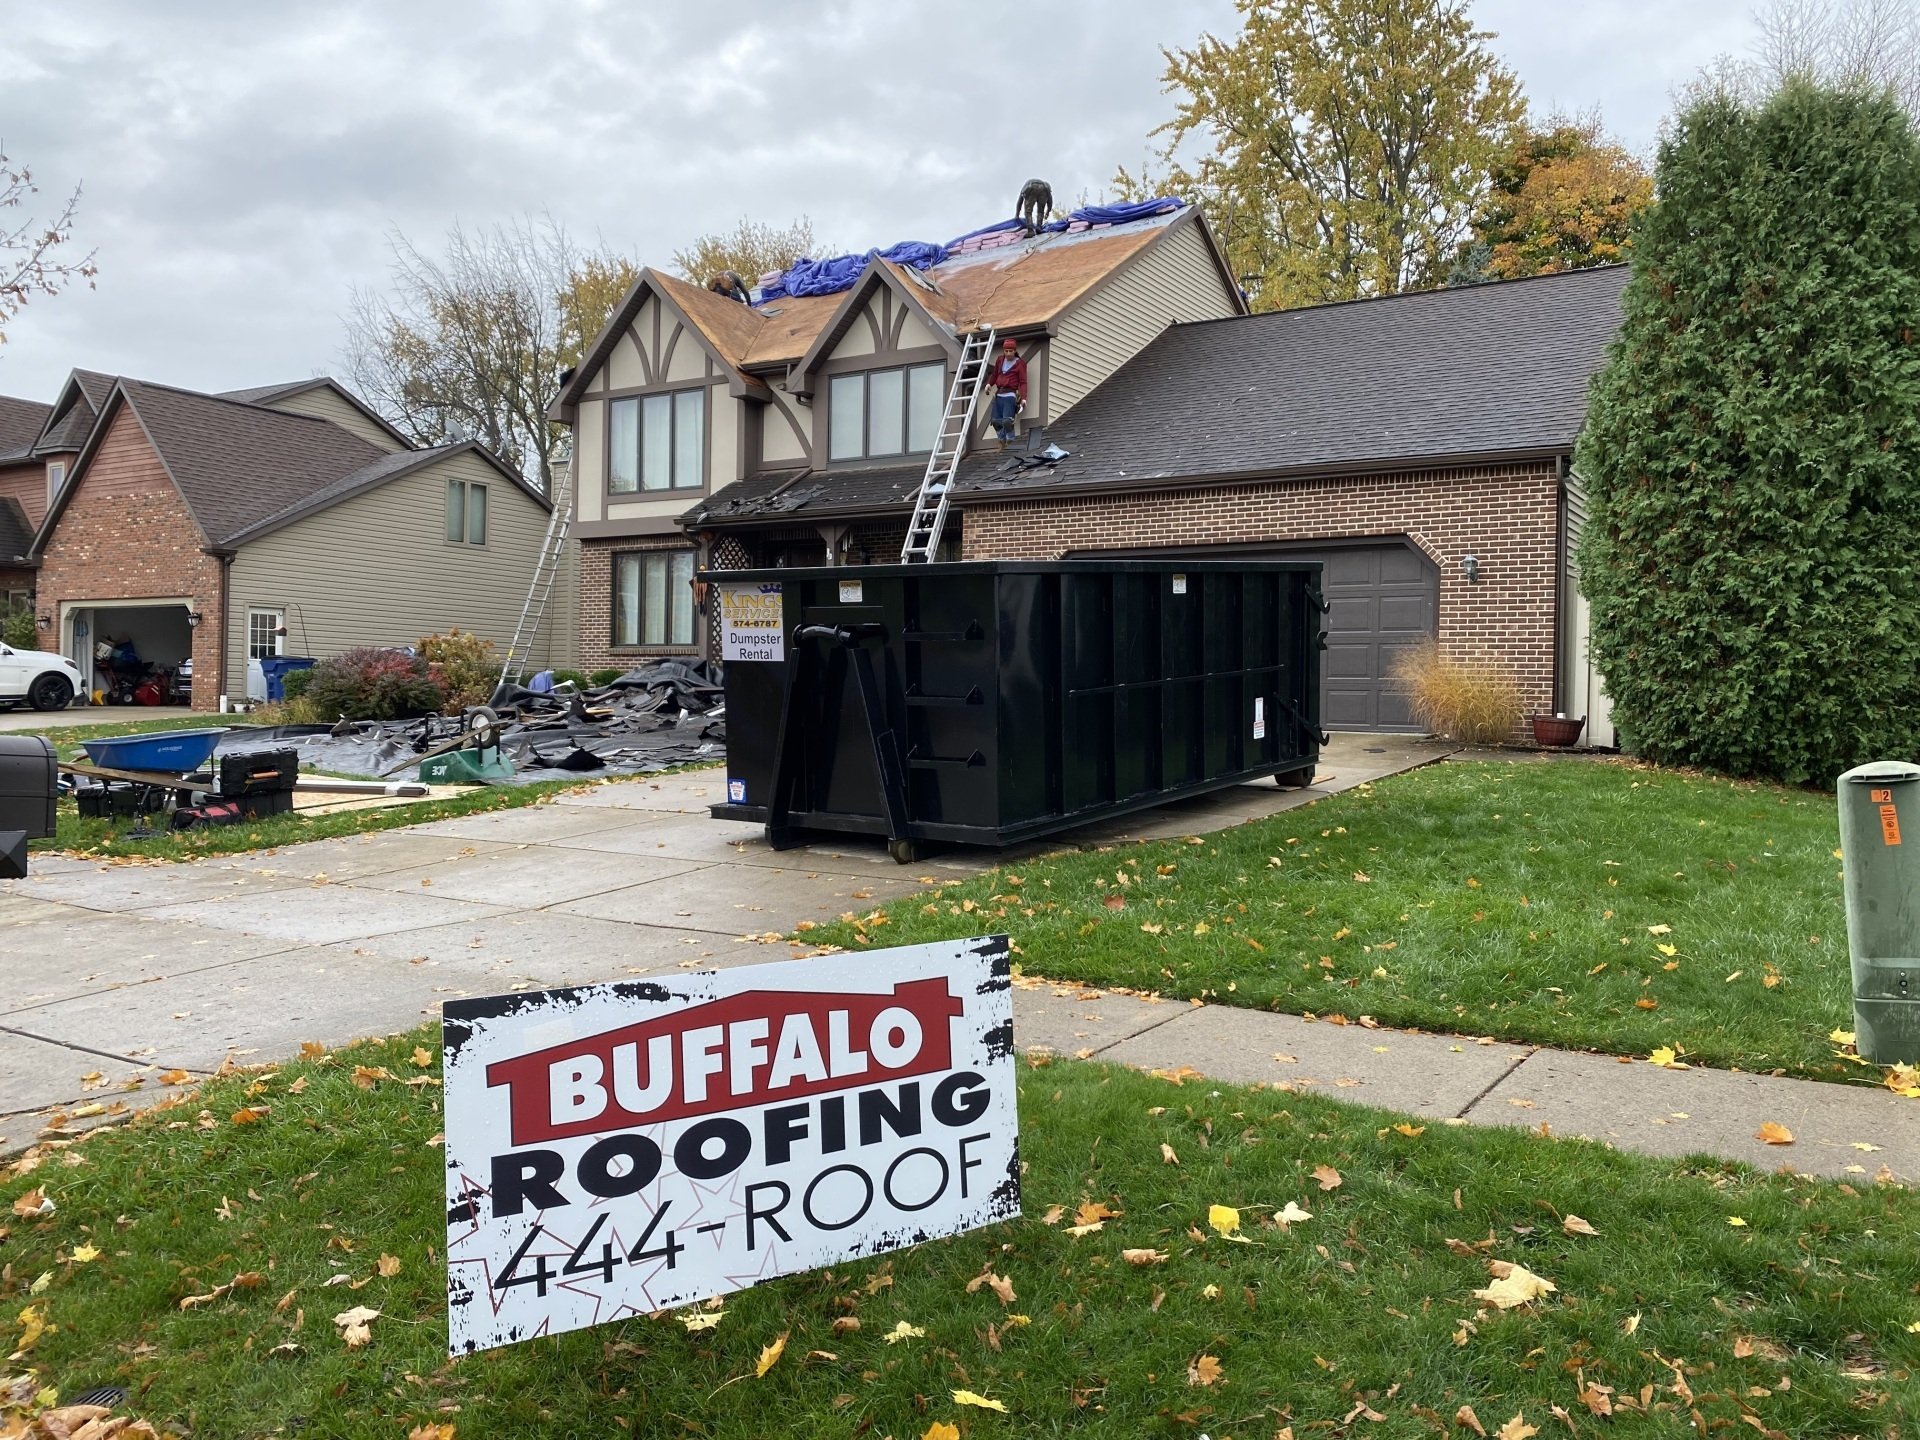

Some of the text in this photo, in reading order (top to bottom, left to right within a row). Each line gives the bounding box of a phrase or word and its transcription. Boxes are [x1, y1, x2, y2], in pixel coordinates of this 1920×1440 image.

[730, 632, 782, 647] Dumpster
[740, 648, 773, 660] Rental
[431, 765, 448, 776] ACE
[1883, 791, 1889, 801] 2
[549, 1006, 924, 1127] BUFFALO
[490, 1071, 991, 1219] ROOFING
[493, 1132, 992, 1298] 444-ROOF
